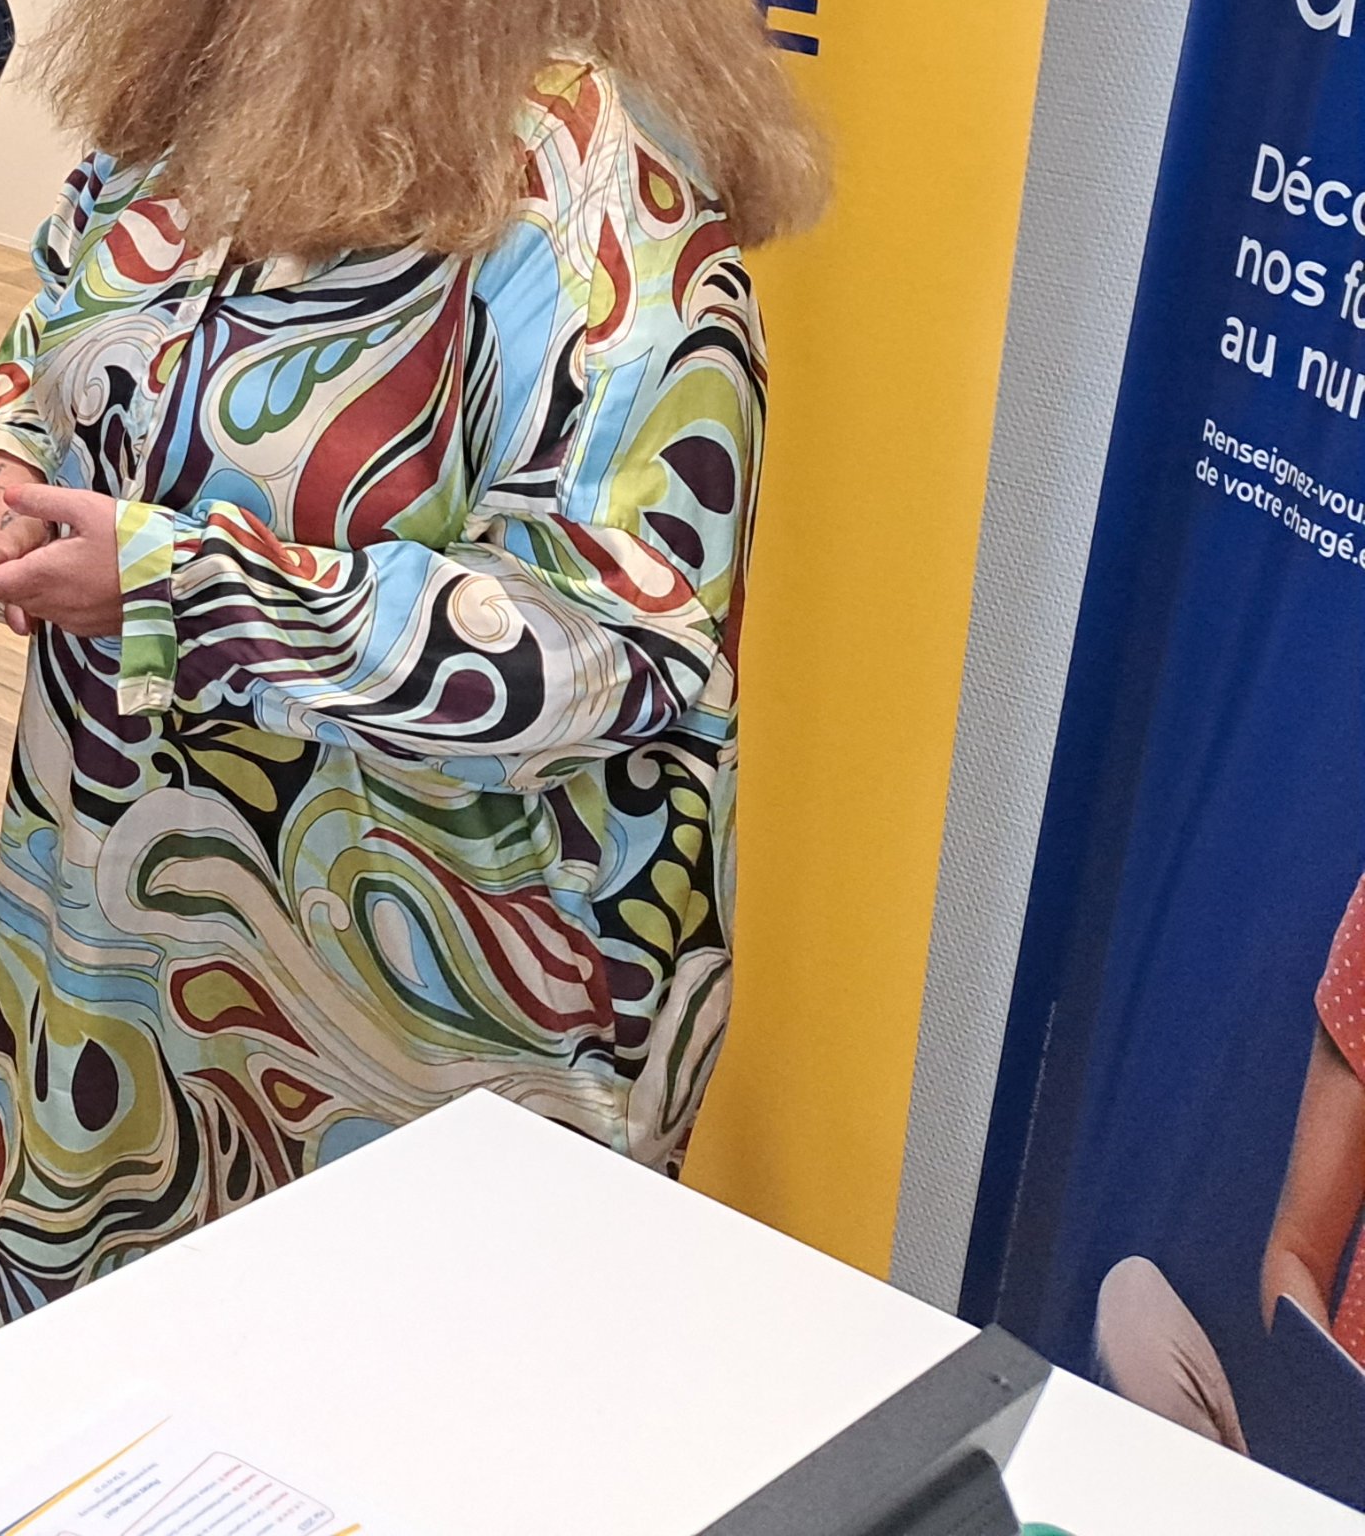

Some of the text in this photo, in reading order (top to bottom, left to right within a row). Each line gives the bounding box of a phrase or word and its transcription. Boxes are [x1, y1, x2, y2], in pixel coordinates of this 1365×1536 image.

[1235, 235, 1328, 307] nos
[1220, 316, 1277, 379] au
[1195, 456, 1219, 487] de
[1223, 473, 1283, 518] votre
[1202, 418, 1365, 526] Renseignez-vou
